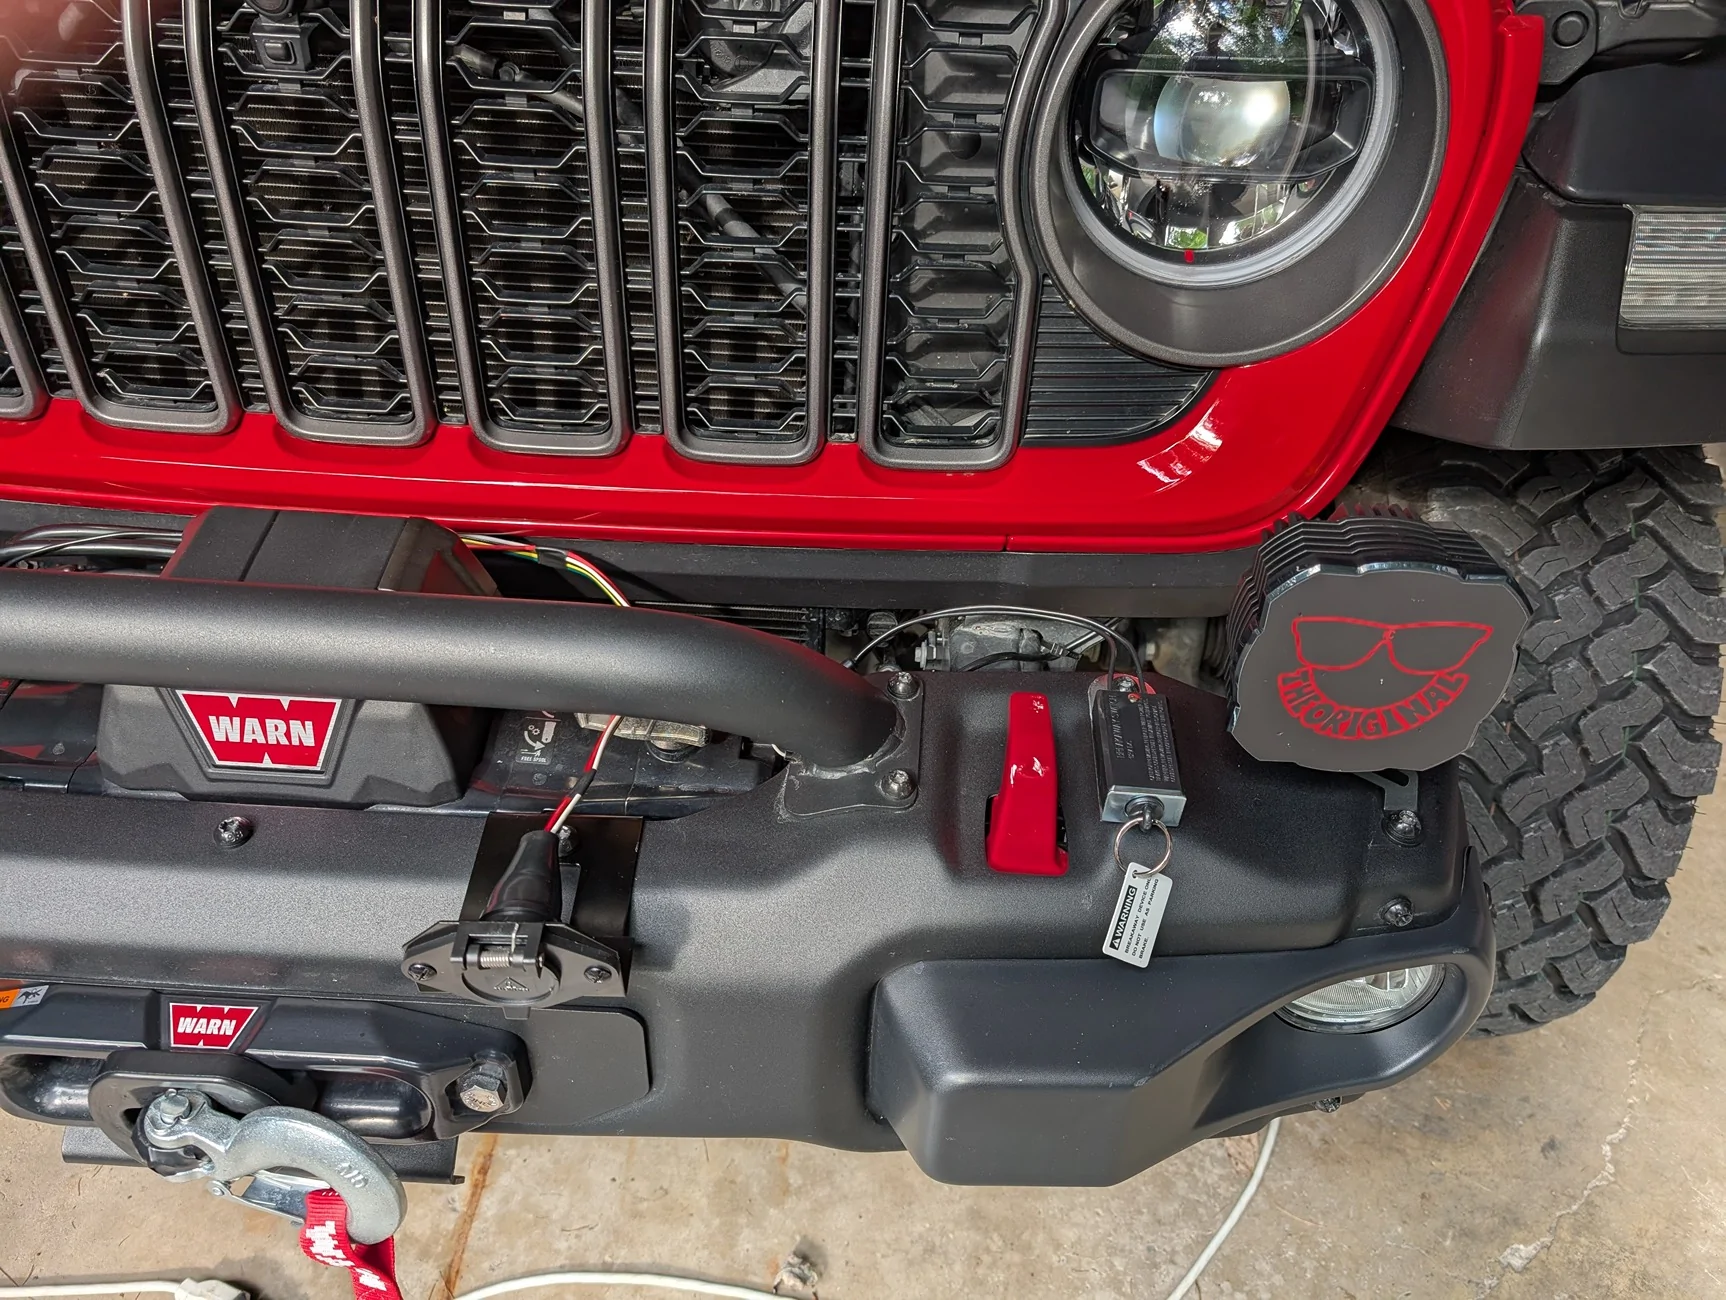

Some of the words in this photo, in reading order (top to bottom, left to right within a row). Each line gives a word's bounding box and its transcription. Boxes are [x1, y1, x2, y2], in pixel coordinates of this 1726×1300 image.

[208, 715, 315, 747] WARN
[1303, 673, 1467, 738] ORIGINAL
[1114, 887, 1136, 940] WARNING
[1125, 915, 1140, 954] BREAKAWAY
[1138, 891, 1148, 913] DEVICE
[1132, 946, 1138, 956] DO
[1144, 908, 1150, 917] AS
[1148, 878, 1159, 906] PARKING
[177, 1016, 237, 1036] WARN
